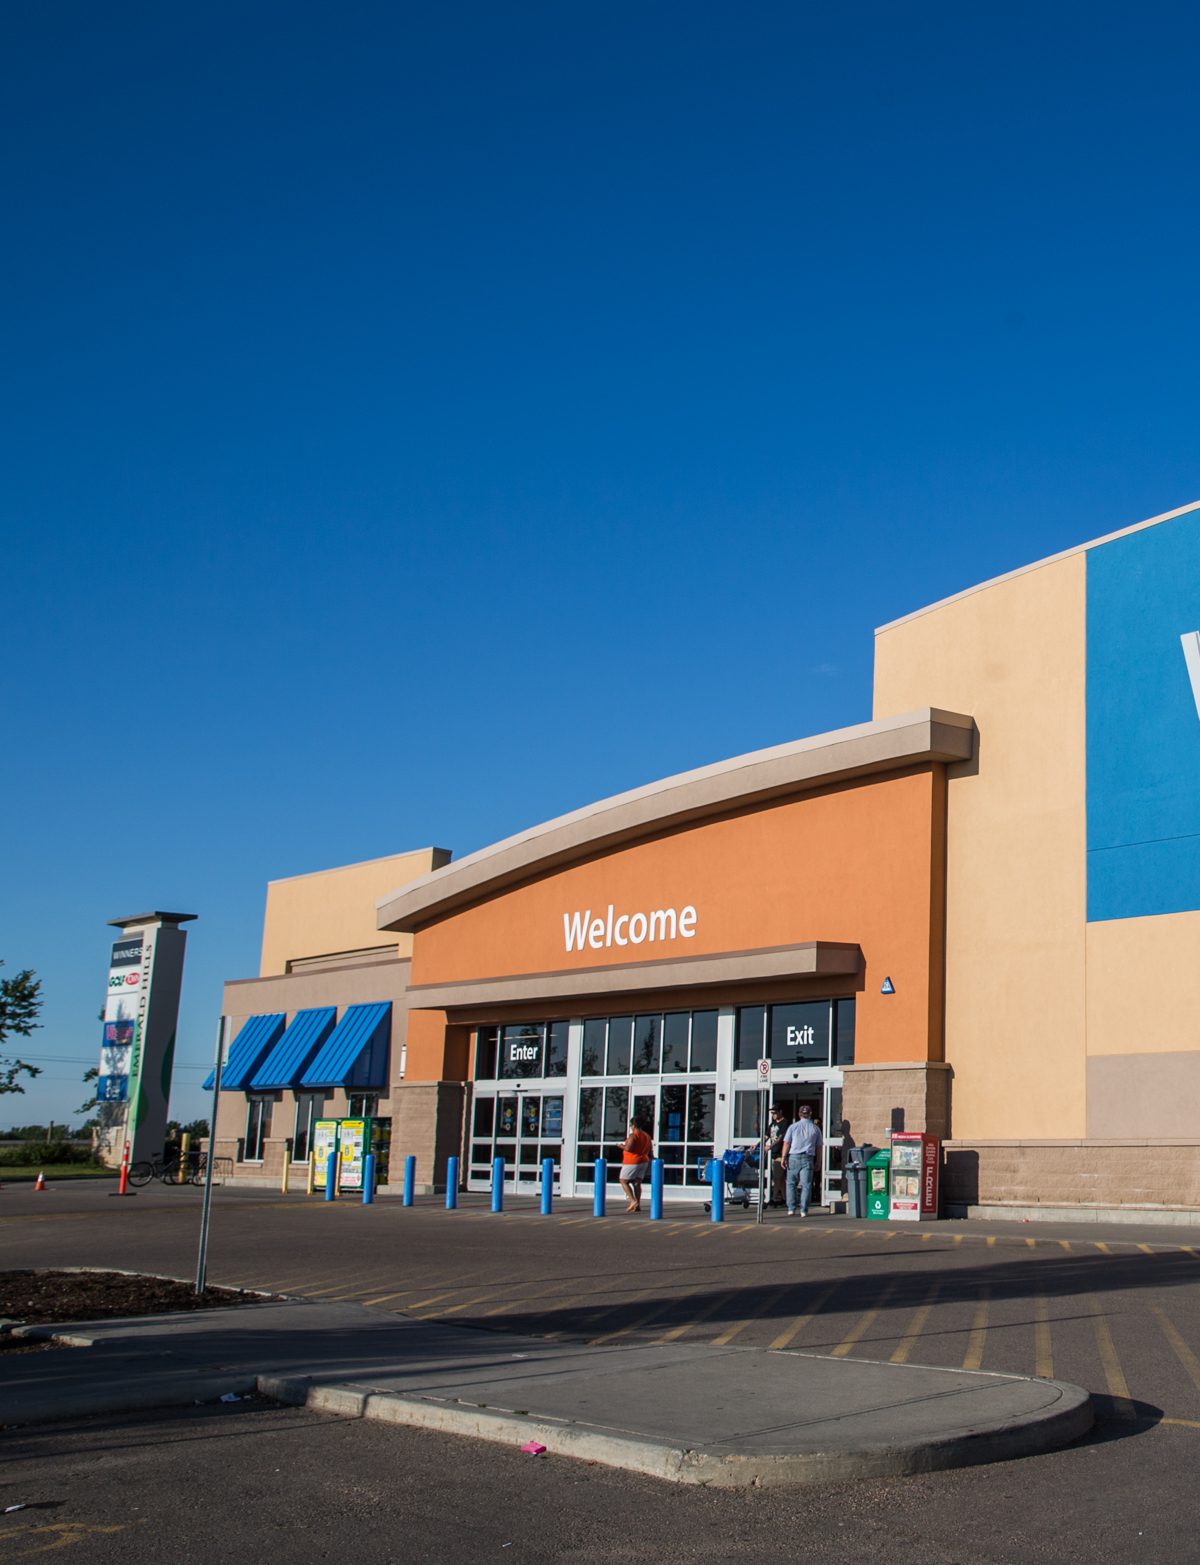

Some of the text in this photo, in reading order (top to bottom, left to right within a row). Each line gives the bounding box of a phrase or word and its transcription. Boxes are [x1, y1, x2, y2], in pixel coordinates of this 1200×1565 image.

[563, 904, 697, 952] Welcome
[132, 944, 152, 1078] EMERALD HILLS
[510, 1044, 538, 1060] Enter
[787, 1025, 814, 1045] Exit
[925, 1166, 934, 1207] FREE
